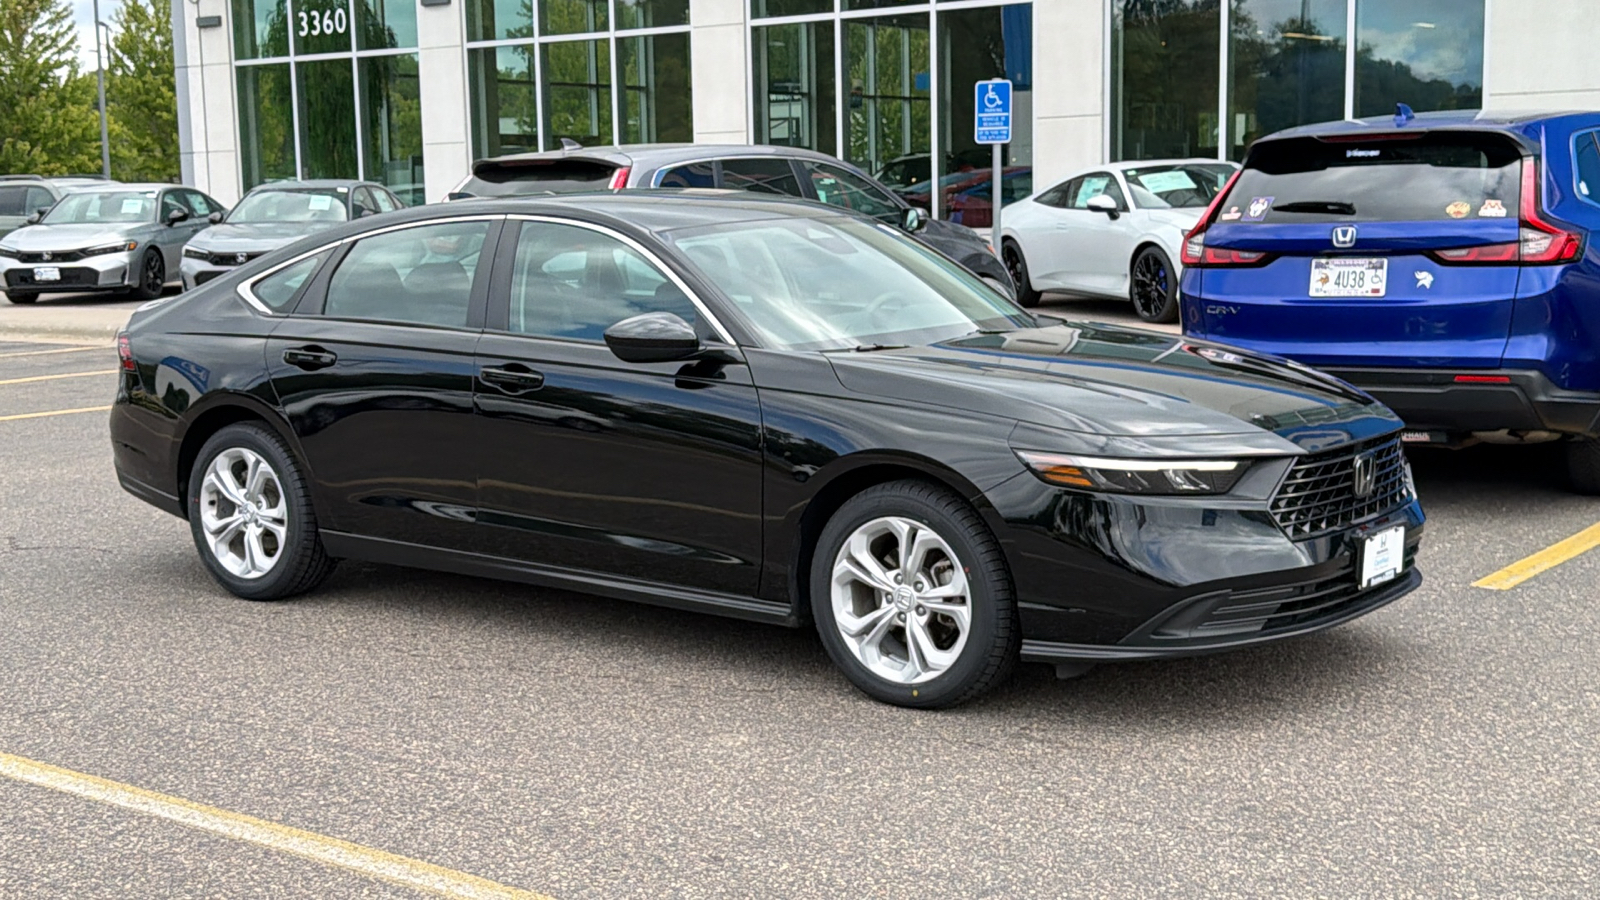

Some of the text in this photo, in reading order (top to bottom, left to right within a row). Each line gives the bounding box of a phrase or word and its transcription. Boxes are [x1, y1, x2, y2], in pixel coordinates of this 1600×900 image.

[298, 8, 347, 37] 3360
[1333, 270, 1366, 289] 4U38
[1206, 305, 1241, 315] CR-V
